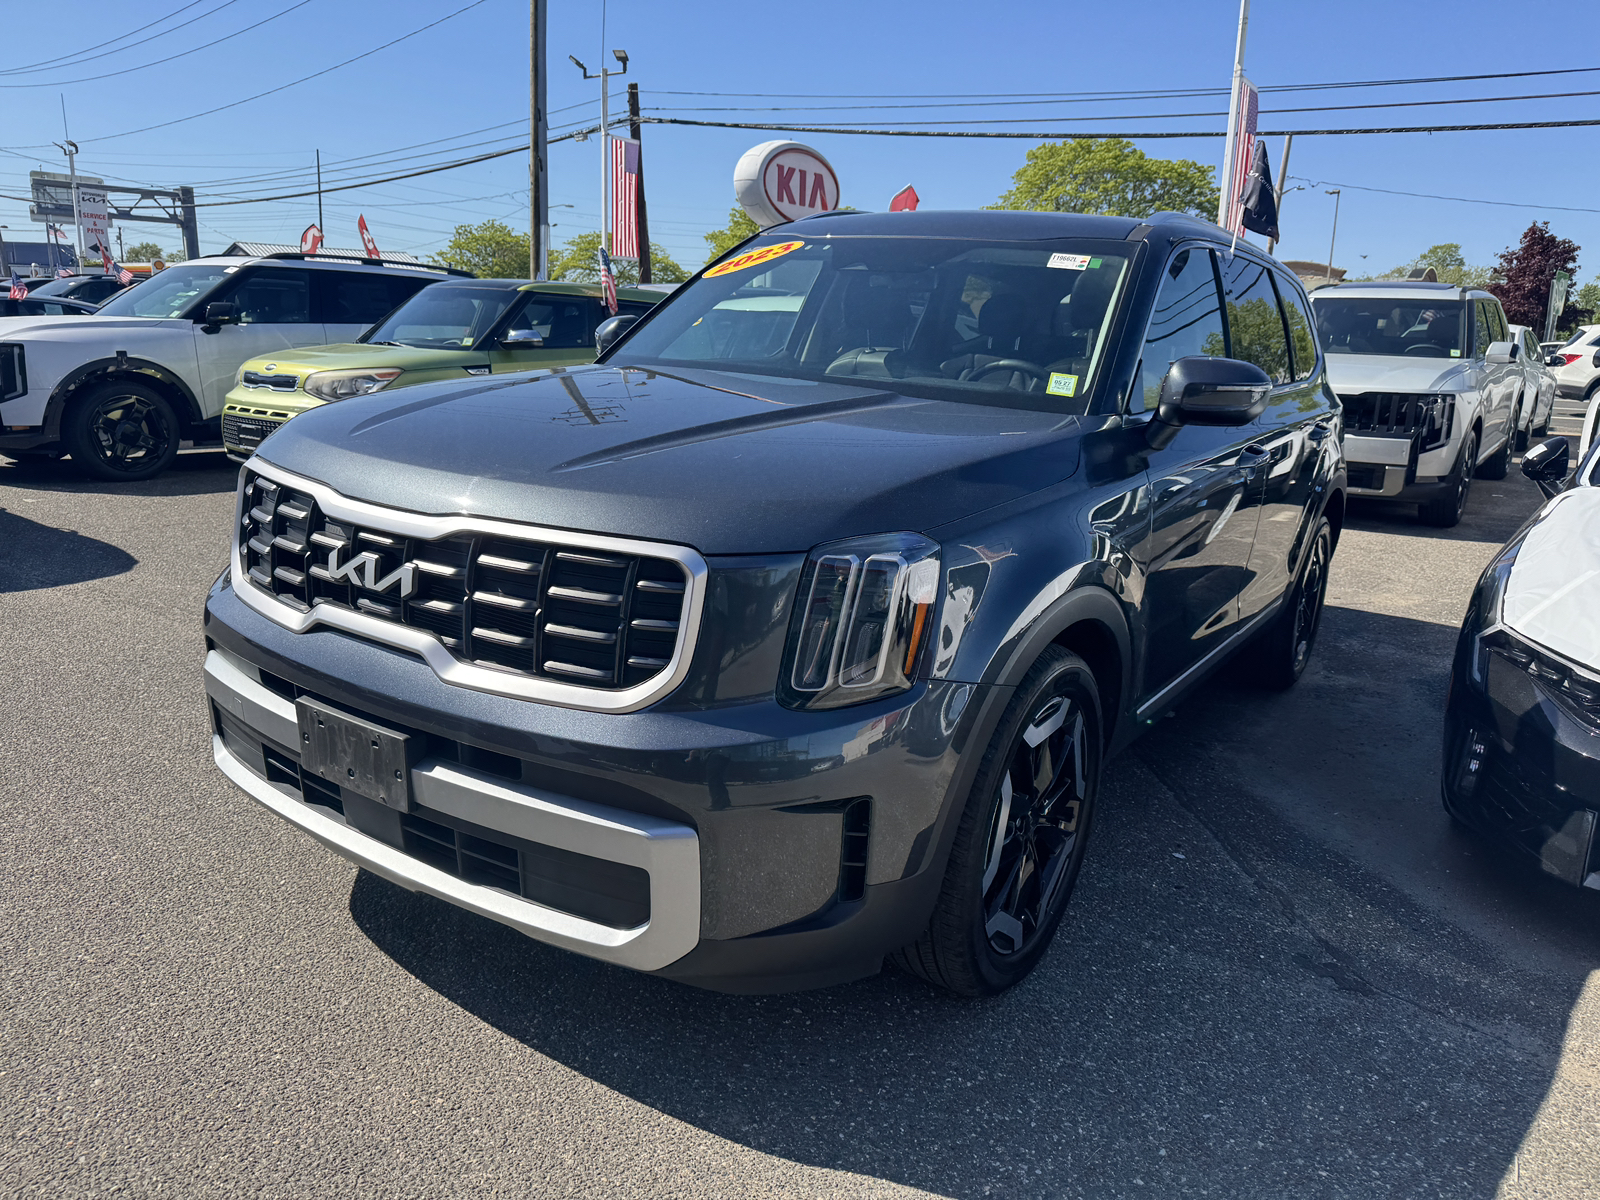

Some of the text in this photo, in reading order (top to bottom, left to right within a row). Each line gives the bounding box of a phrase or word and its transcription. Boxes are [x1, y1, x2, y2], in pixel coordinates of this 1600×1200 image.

[776, 163, 828, 211] KIA
[1259, 176, 1273, 194] Certifie
[82, 196, 106, 204] KIA
[82, 212, 106, 220] SERVICE
[711, 243, 795, 276] 2023
[328, 545, 417, 599] KIA
